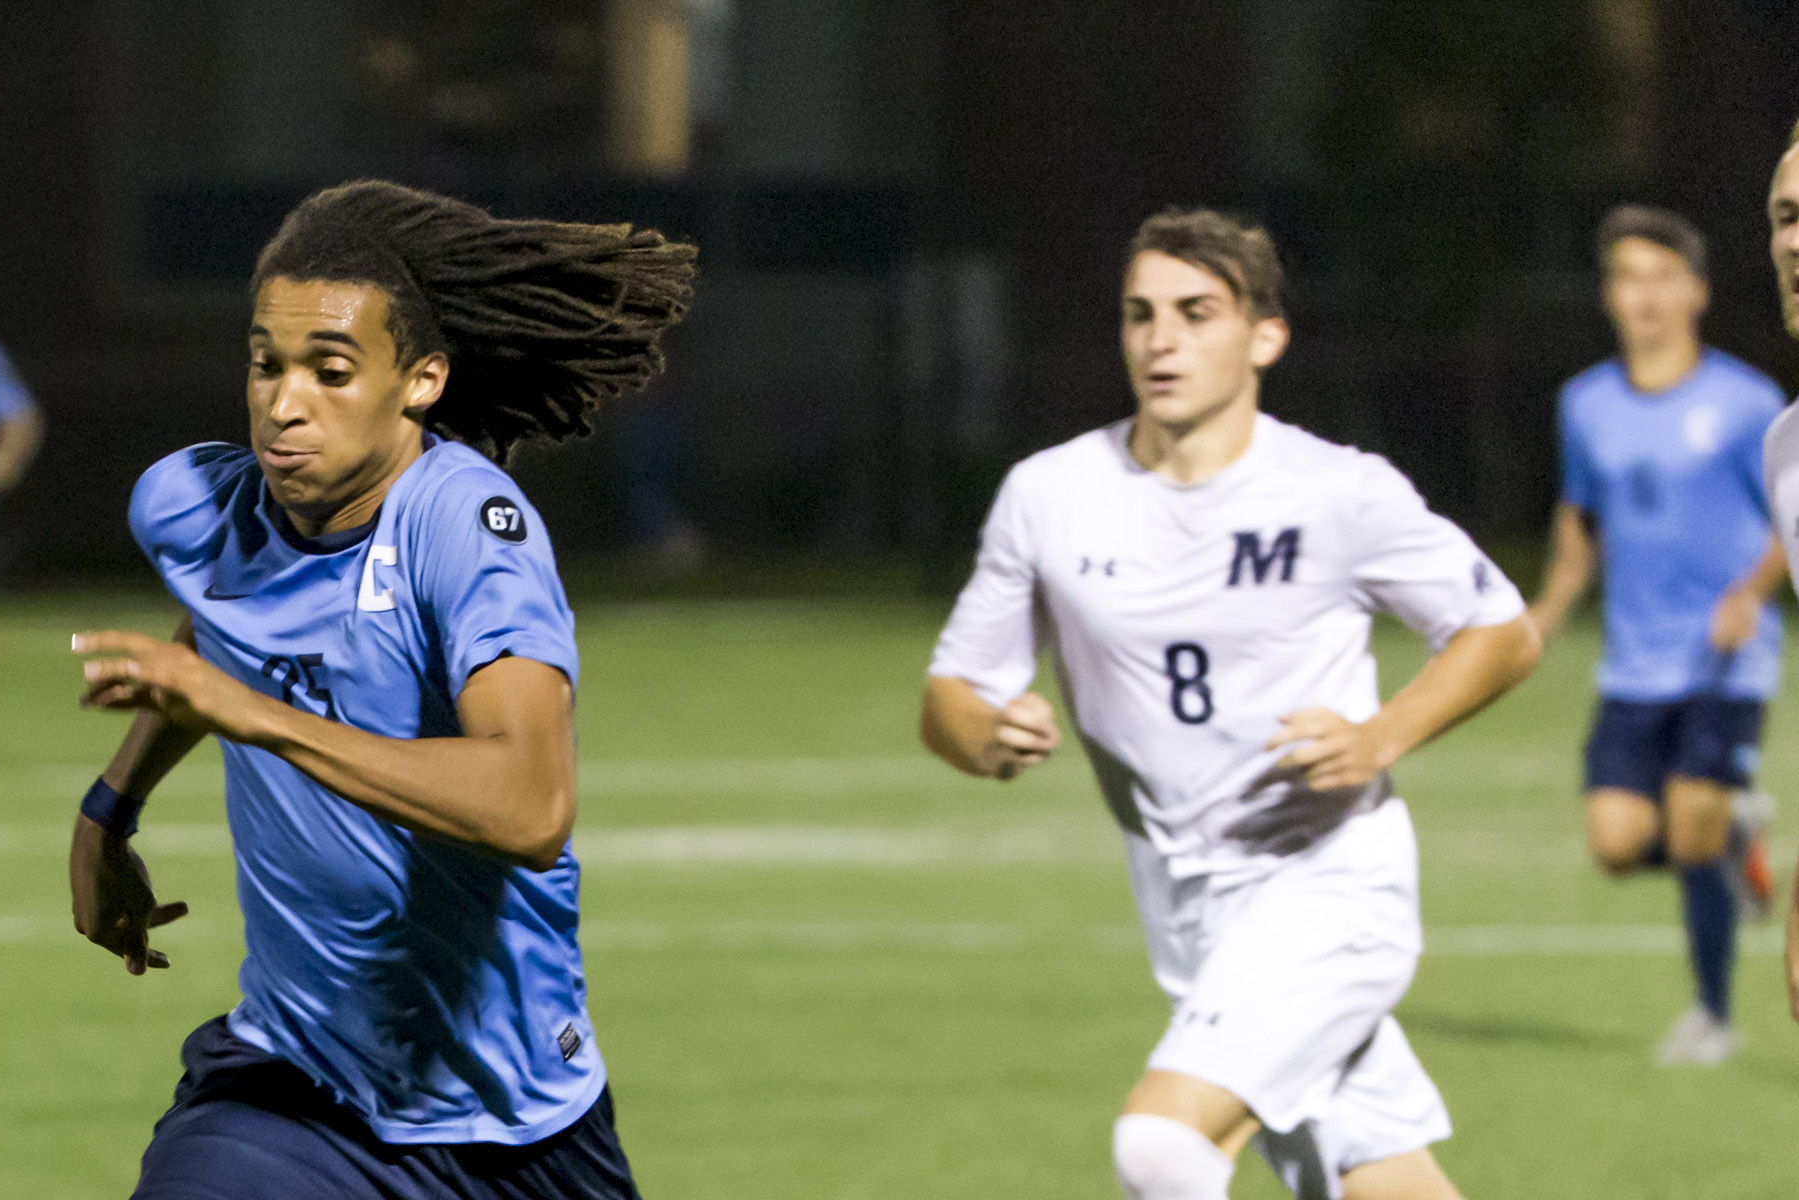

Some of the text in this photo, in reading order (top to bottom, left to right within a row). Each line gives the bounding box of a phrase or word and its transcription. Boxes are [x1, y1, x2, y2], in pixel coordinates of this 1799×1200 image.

[487, 507, 520, 532] 67
[357, 545, 397, 612] C
[1226, 528, 1302, 587] M
[1165, 642, 1214, 725] 8
